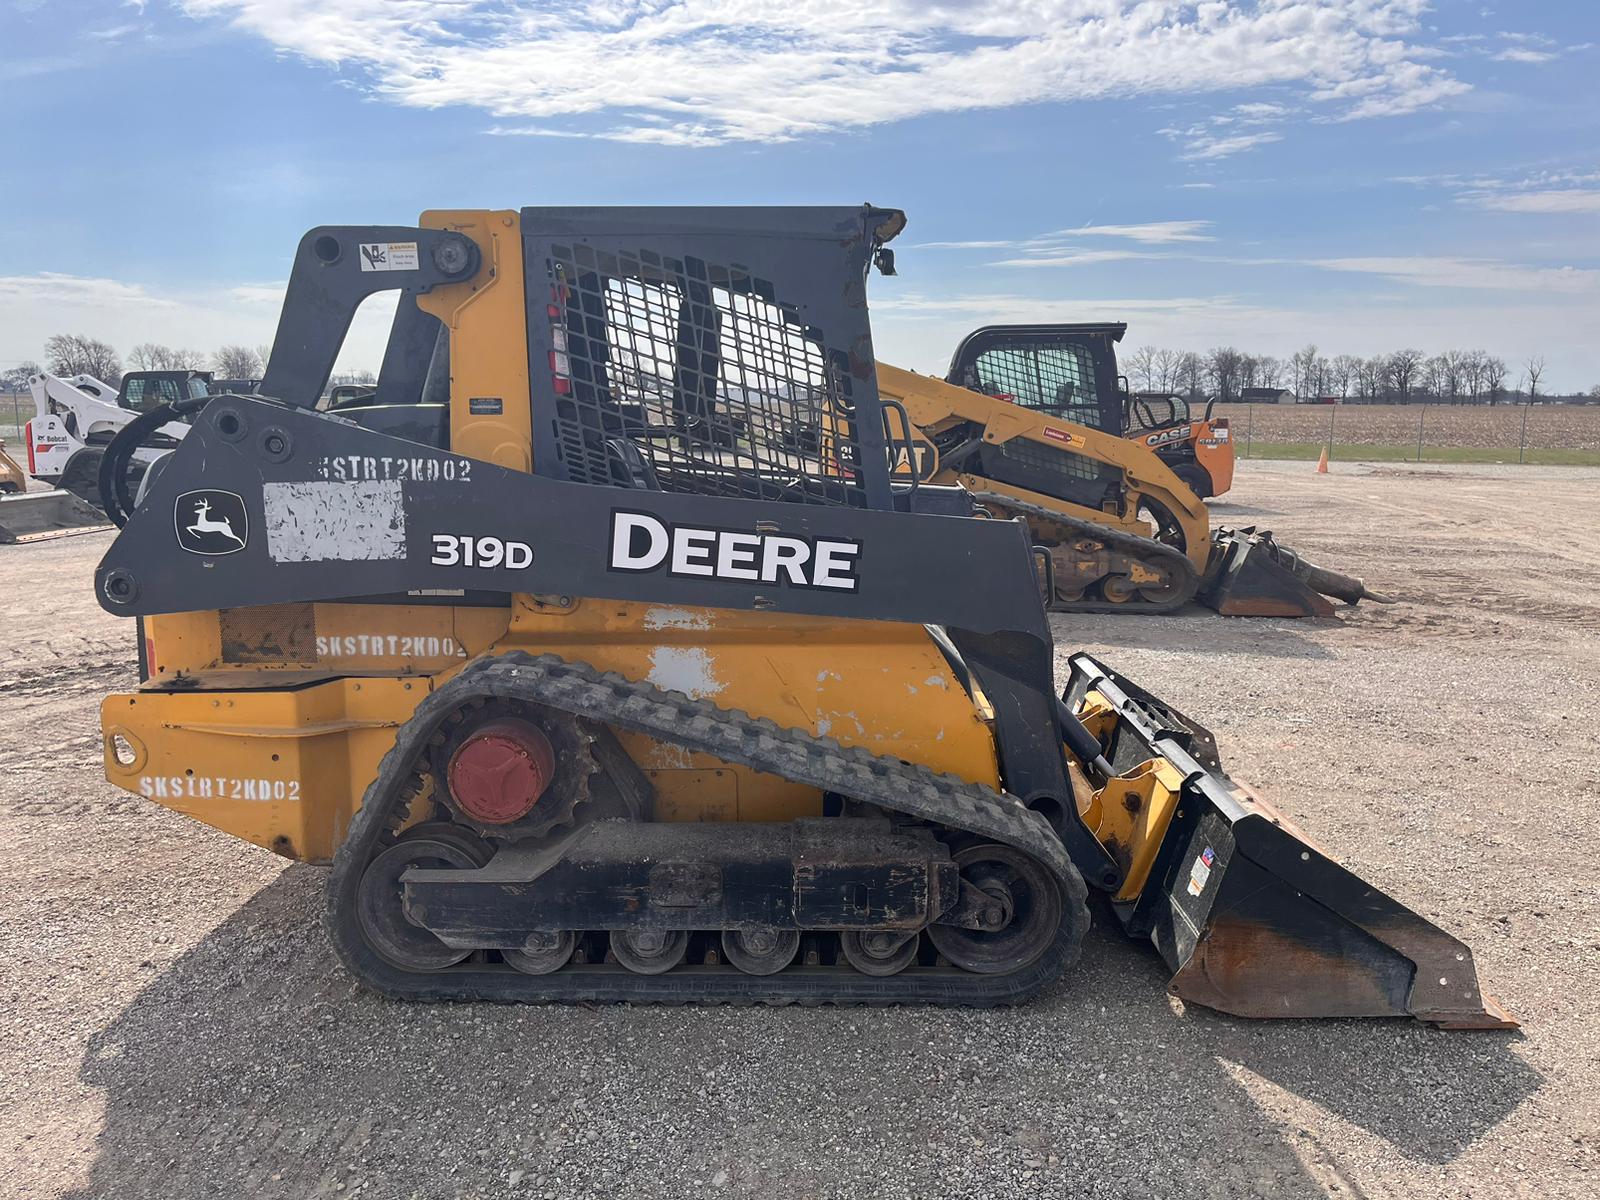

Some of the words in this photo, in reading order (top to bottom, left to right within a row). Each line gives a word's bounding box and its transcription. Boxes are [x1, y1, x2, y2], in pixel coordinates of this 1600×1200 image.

[1146, 425, 1191, 446] CASE
[317, 455, 472, 482] STRT2KD02
[431, 534, 533, 570] 319D
[611, 512, 859, 589] DEERE
[139, 775, 301, 801] SKSTRT2KD02
